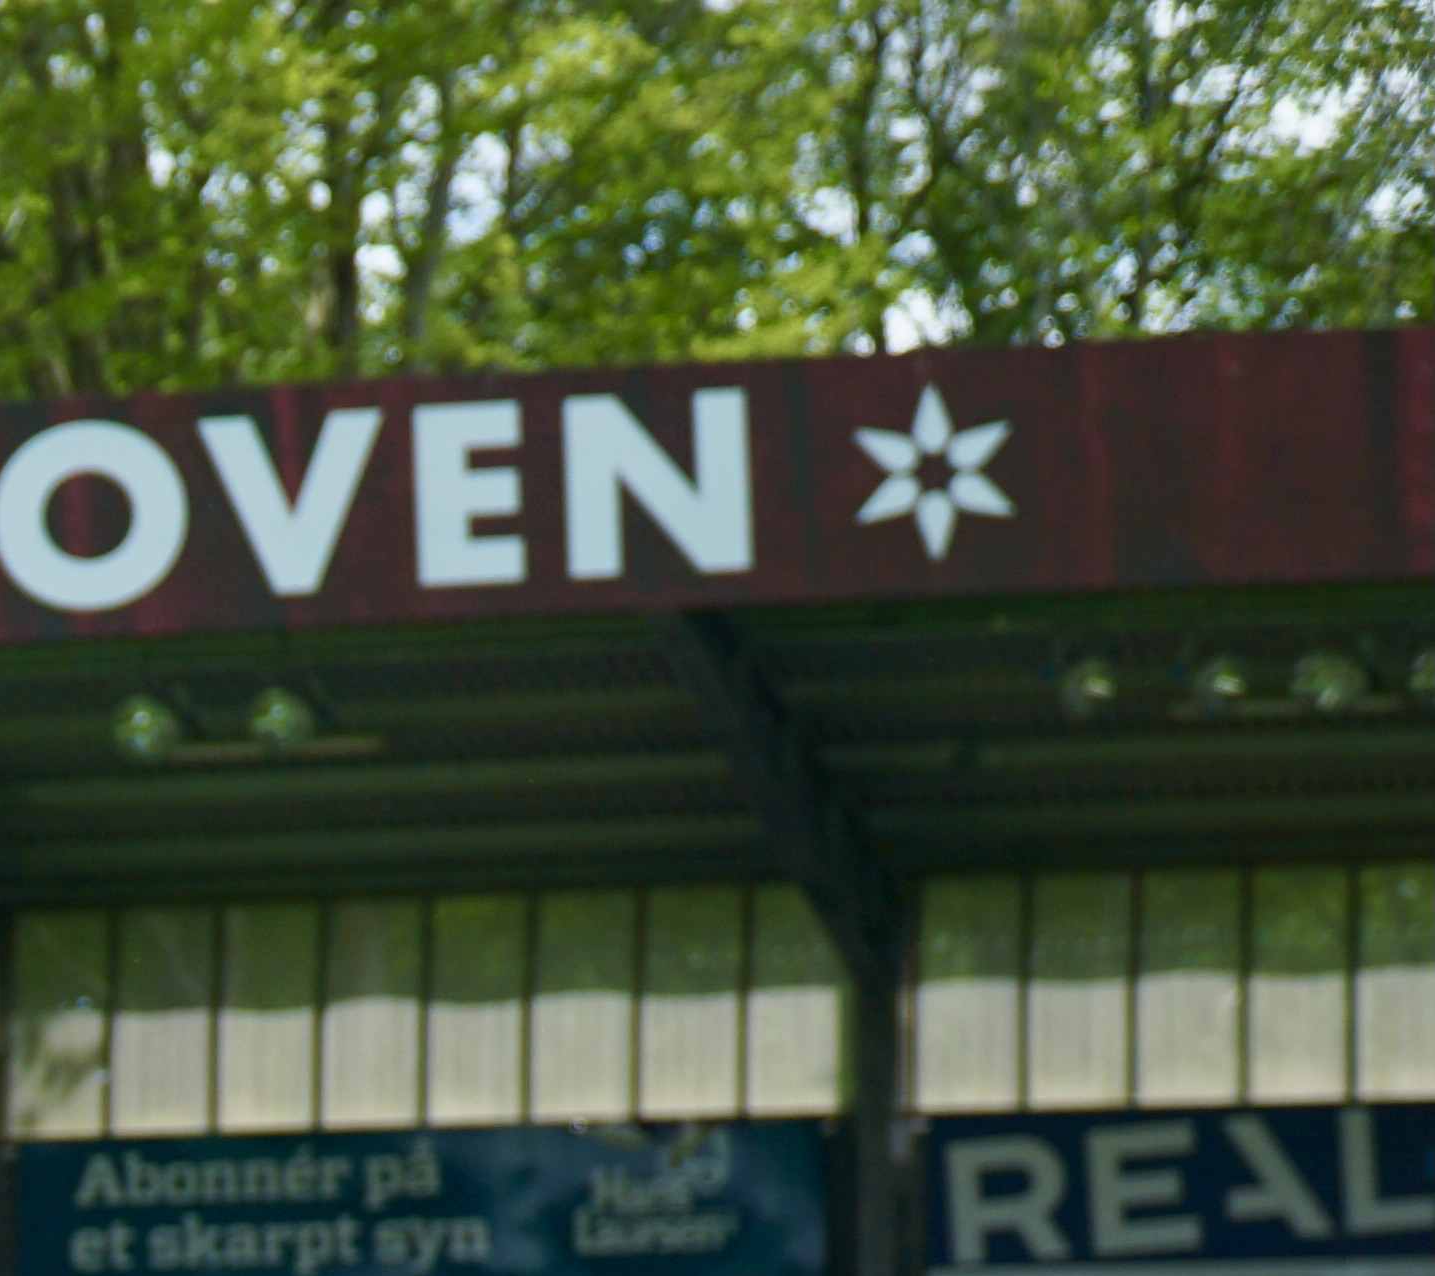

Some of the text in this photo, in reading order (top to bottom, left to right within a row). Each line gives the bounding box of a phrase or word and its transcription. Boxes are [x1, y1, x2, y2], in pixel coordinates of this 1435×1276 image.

[74, 1137, 441, 1212] Abonnér på
[946, 1107, 1435, 1264] REAL
[67, 1219, 136, 1272] et
[372, 1215, 492, 1274] syn
